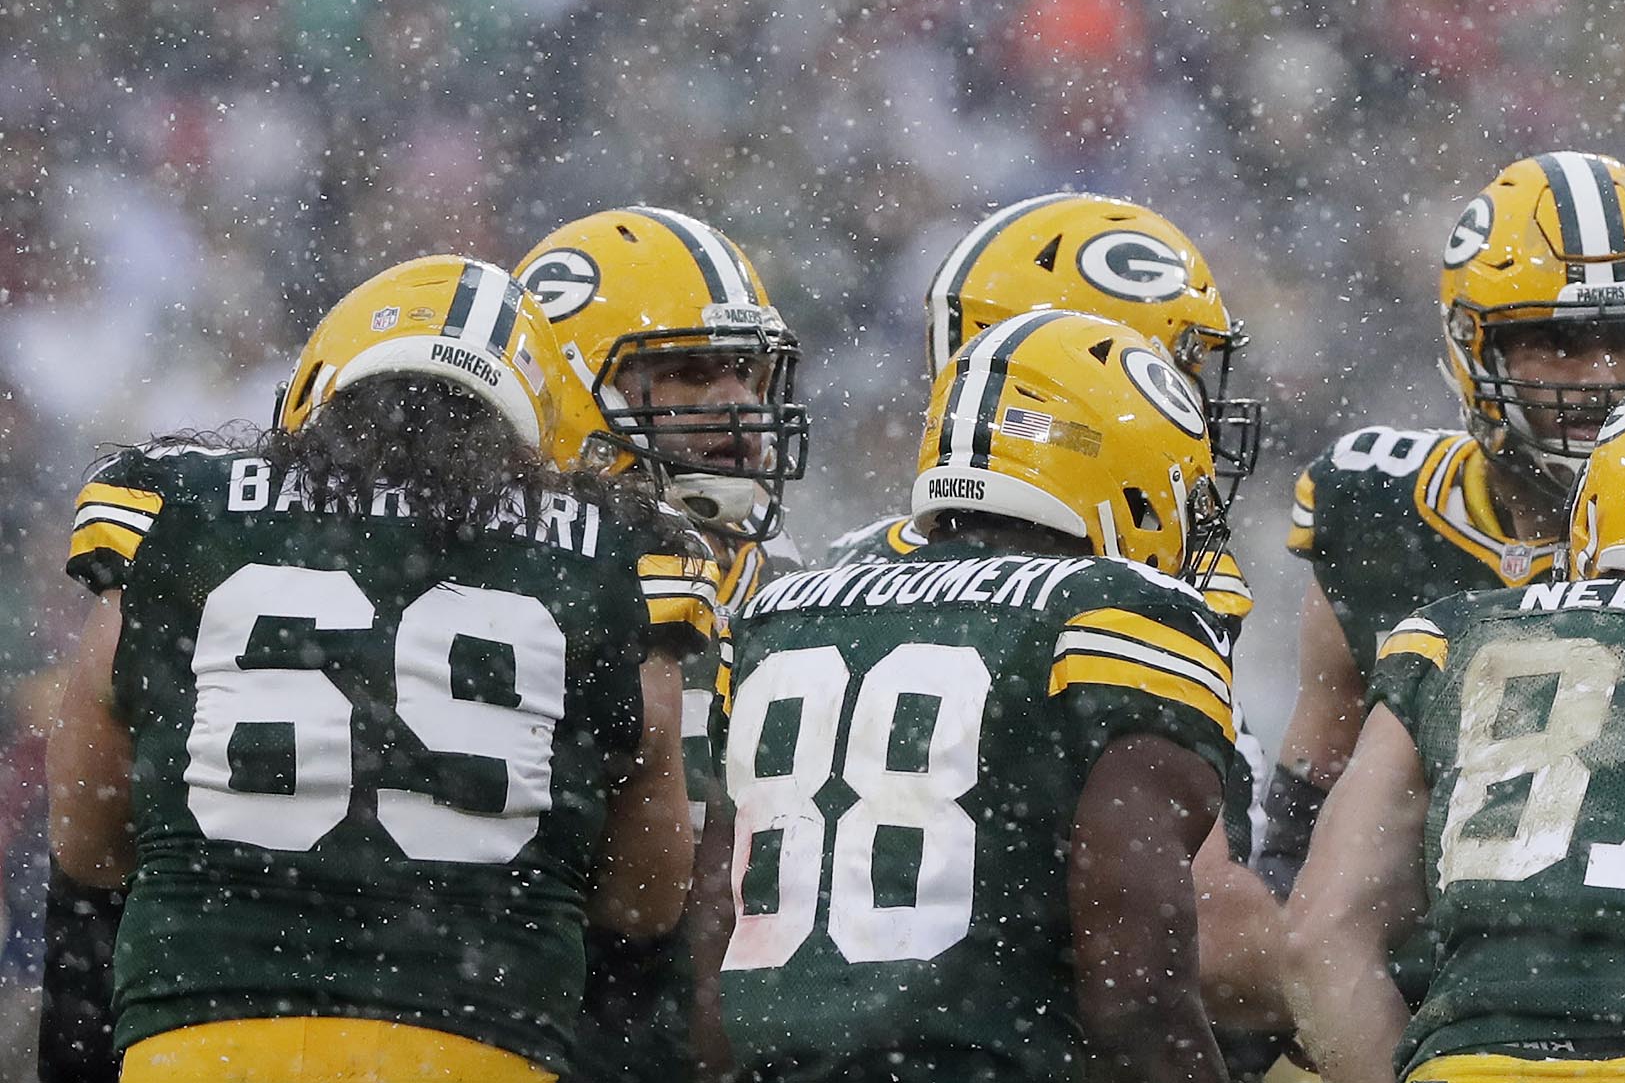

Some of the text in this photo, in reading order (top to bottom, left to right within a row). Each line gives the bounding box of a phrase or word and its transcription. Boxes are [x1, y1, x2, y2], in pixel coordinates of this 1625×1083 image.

[1444, 198, 1490, 265] G
[518, 250, 597, 320] G
[1081, 232, 1187, 299] G
[1577, 287, 1625, 302] PACKERS
[431, 343, 501, 386] PACKERS
[1125, 350, 1205, 435] G
[928, 478, 985, 500] PACKERS
[742, 555, 1095, 620] MONTGOMERY
[184, 562, 566, 864] 69
[720, 643, 993, 972] 88
